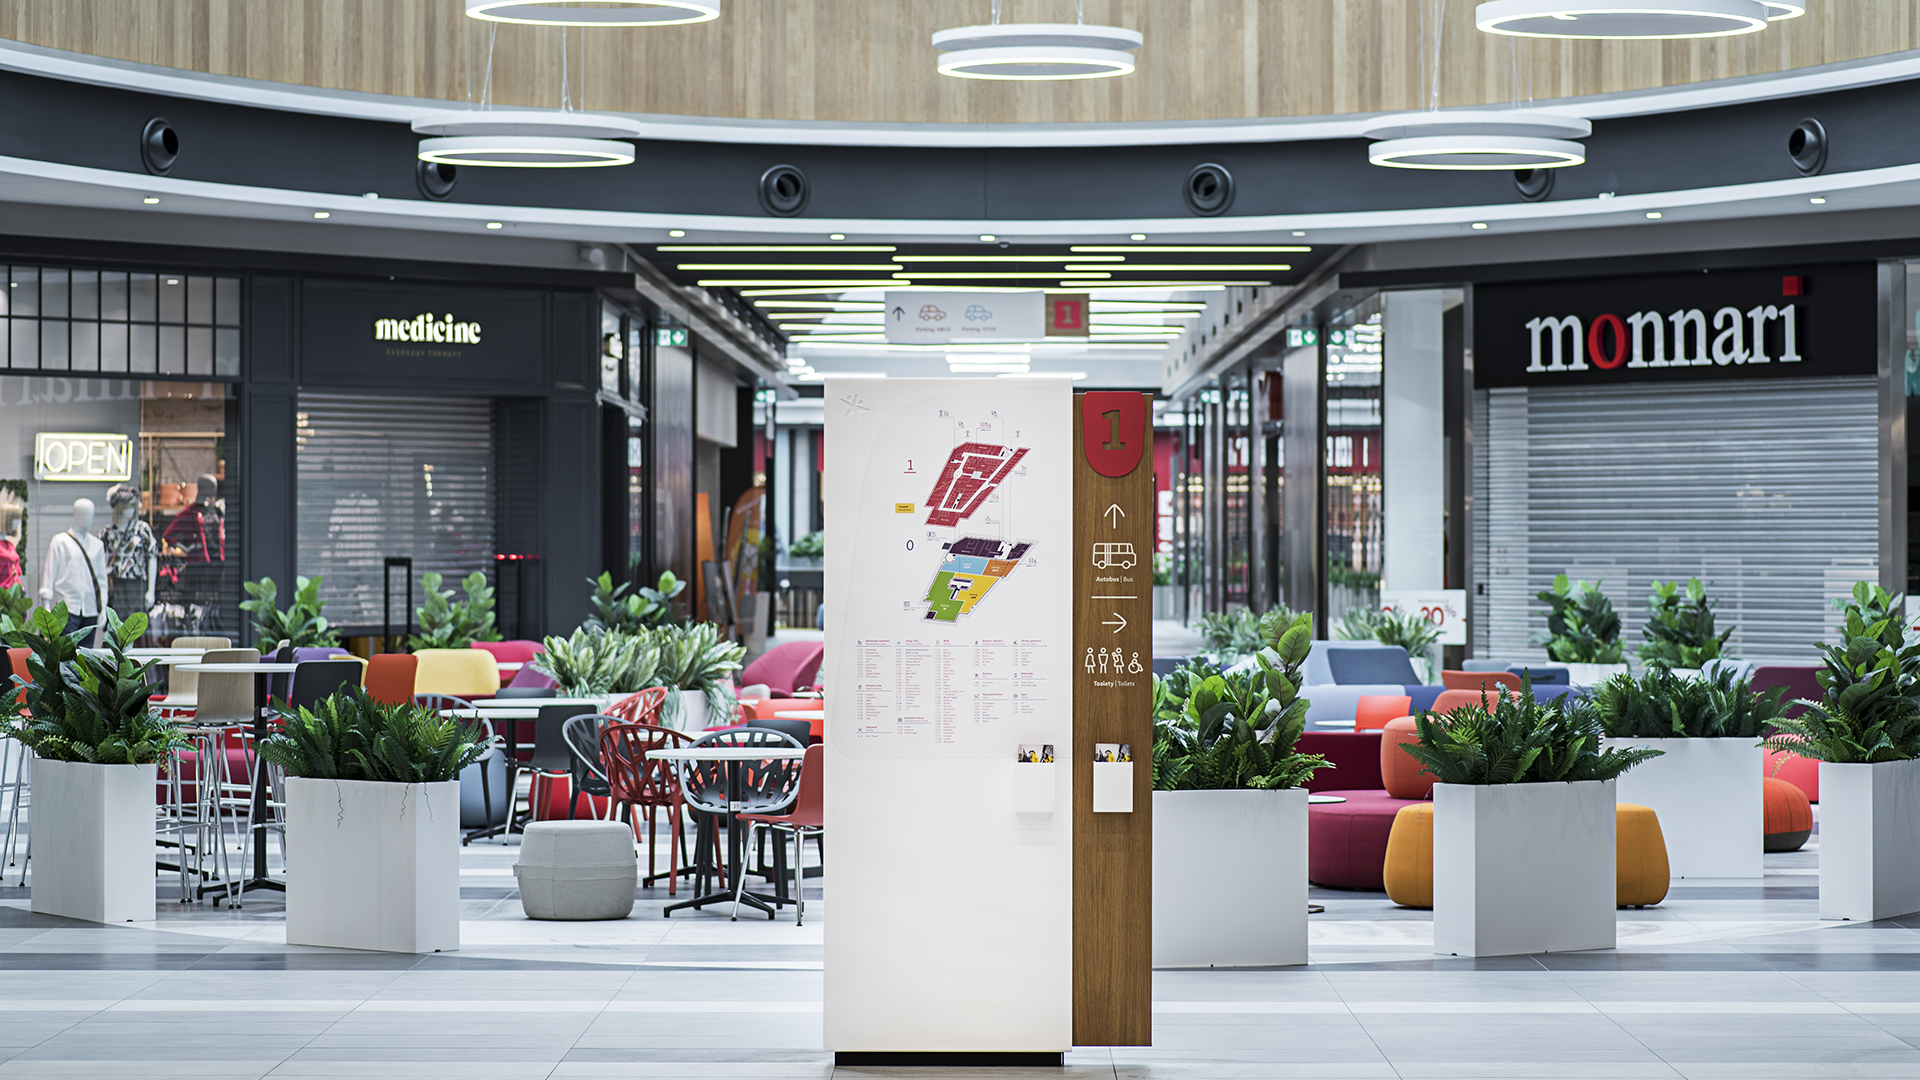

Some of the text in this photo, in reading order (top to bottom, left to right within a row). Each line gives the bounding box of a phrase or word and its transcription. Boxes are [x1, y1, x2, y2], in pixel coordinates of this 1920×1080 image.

[1062, 305, 1073, 324] 1
[1525, 276, 1802, 373] monnari
[375, 312, 481, 345] medicine
[386, 348, 462, 357] EVERYDAY THERAPY
[1102, 409, 1126, 450] 1
[44, 441, 127, 474] OPEN
[907, 459, 914, 471] 1
[1093, 680, 1114, 688] Toalety
